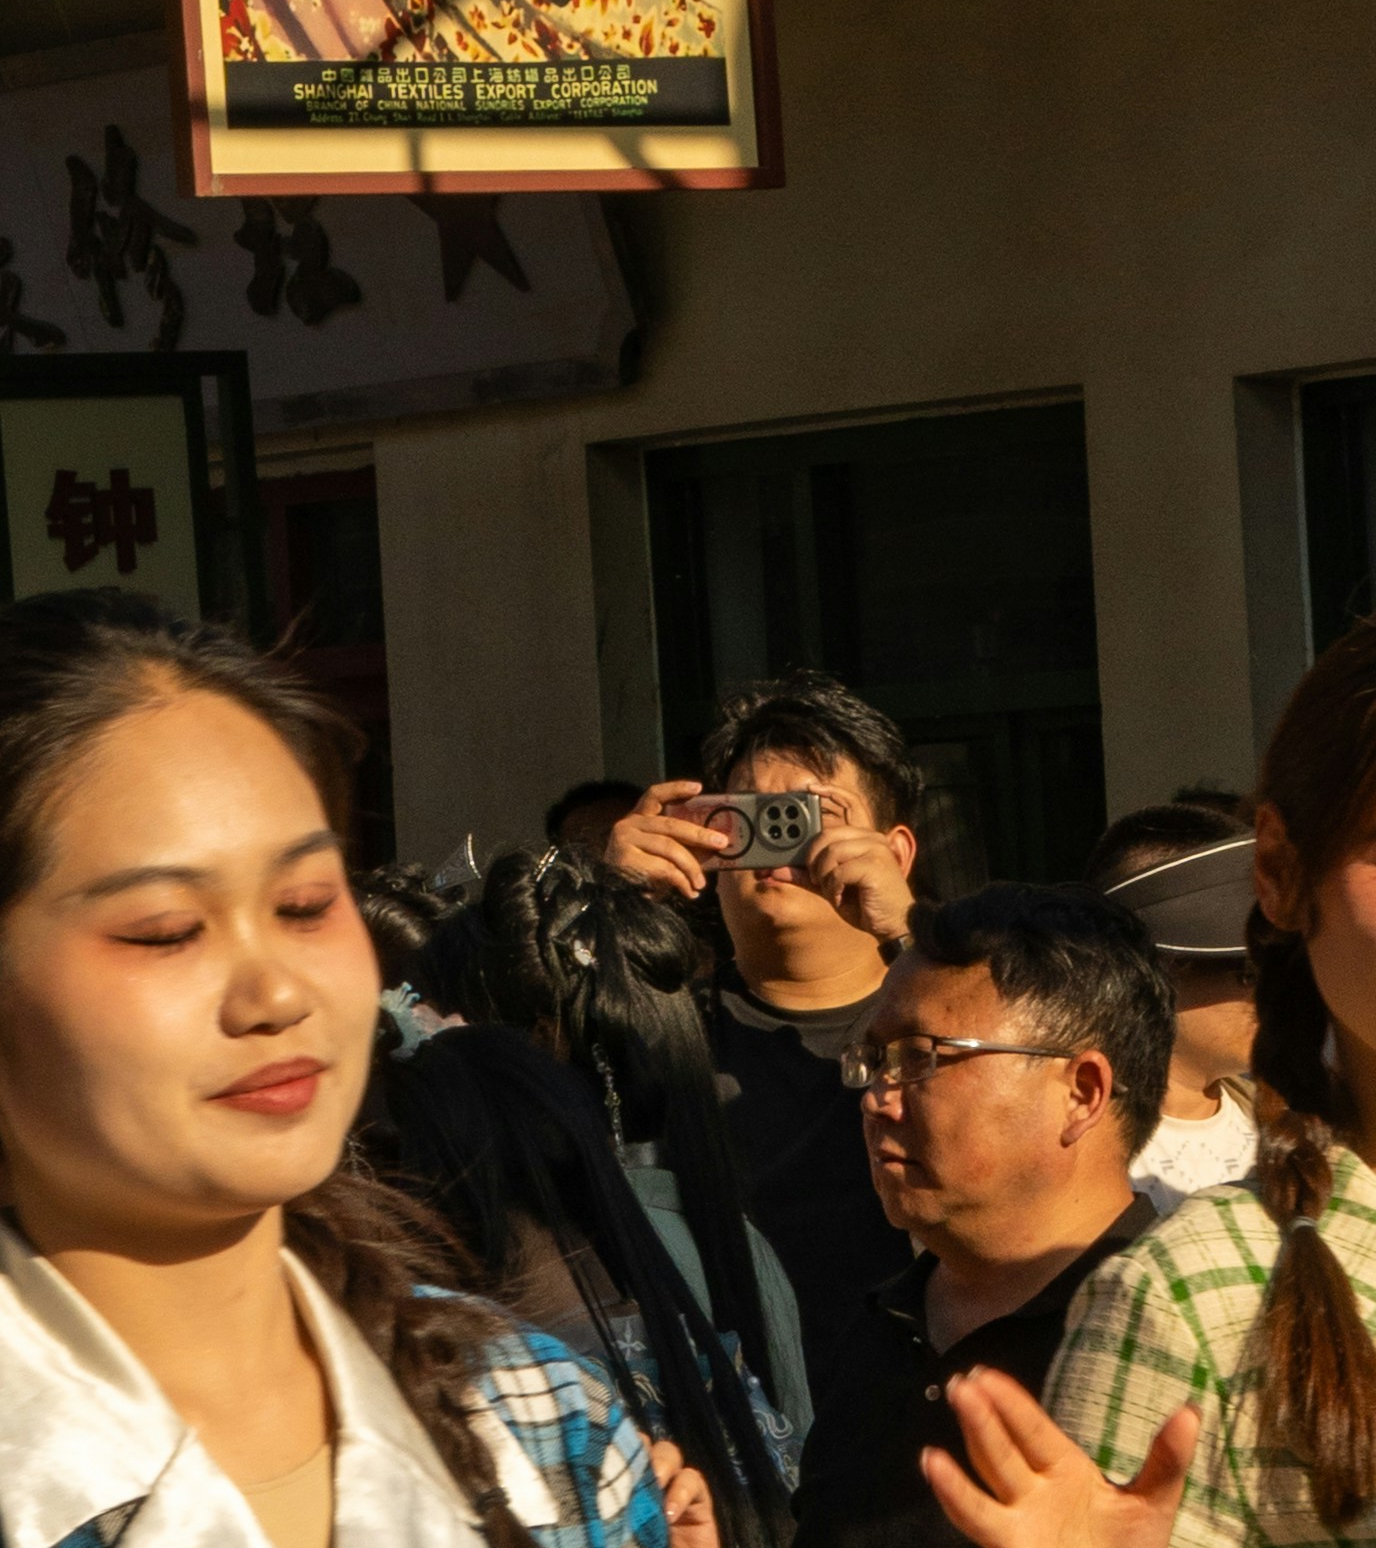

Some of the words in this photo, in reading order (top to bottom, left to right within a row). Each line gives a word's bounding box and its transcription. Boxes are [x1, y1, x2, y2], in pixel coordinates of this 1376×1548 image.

[293, 83, 373, 100] SHANGHAI
[388, 84, 464, 100] TEXTILES
[476, 83, 537, 100] EXPORT
[551, 79, 658, 99] CORPORATION
[306, 101, 347, 112] BRANCH
[355, 101, 370, 111] OF
[378, 101, 408, 111] CHINA
[416, 100, 466, 111] NATIONAL
[475, 100, 525, 111] SUNDRIES
[533, 99, 572, 110] EXPORT
[581, 95, 648, 109] CORPORATION
[46, 468, 158, 574] 钟
